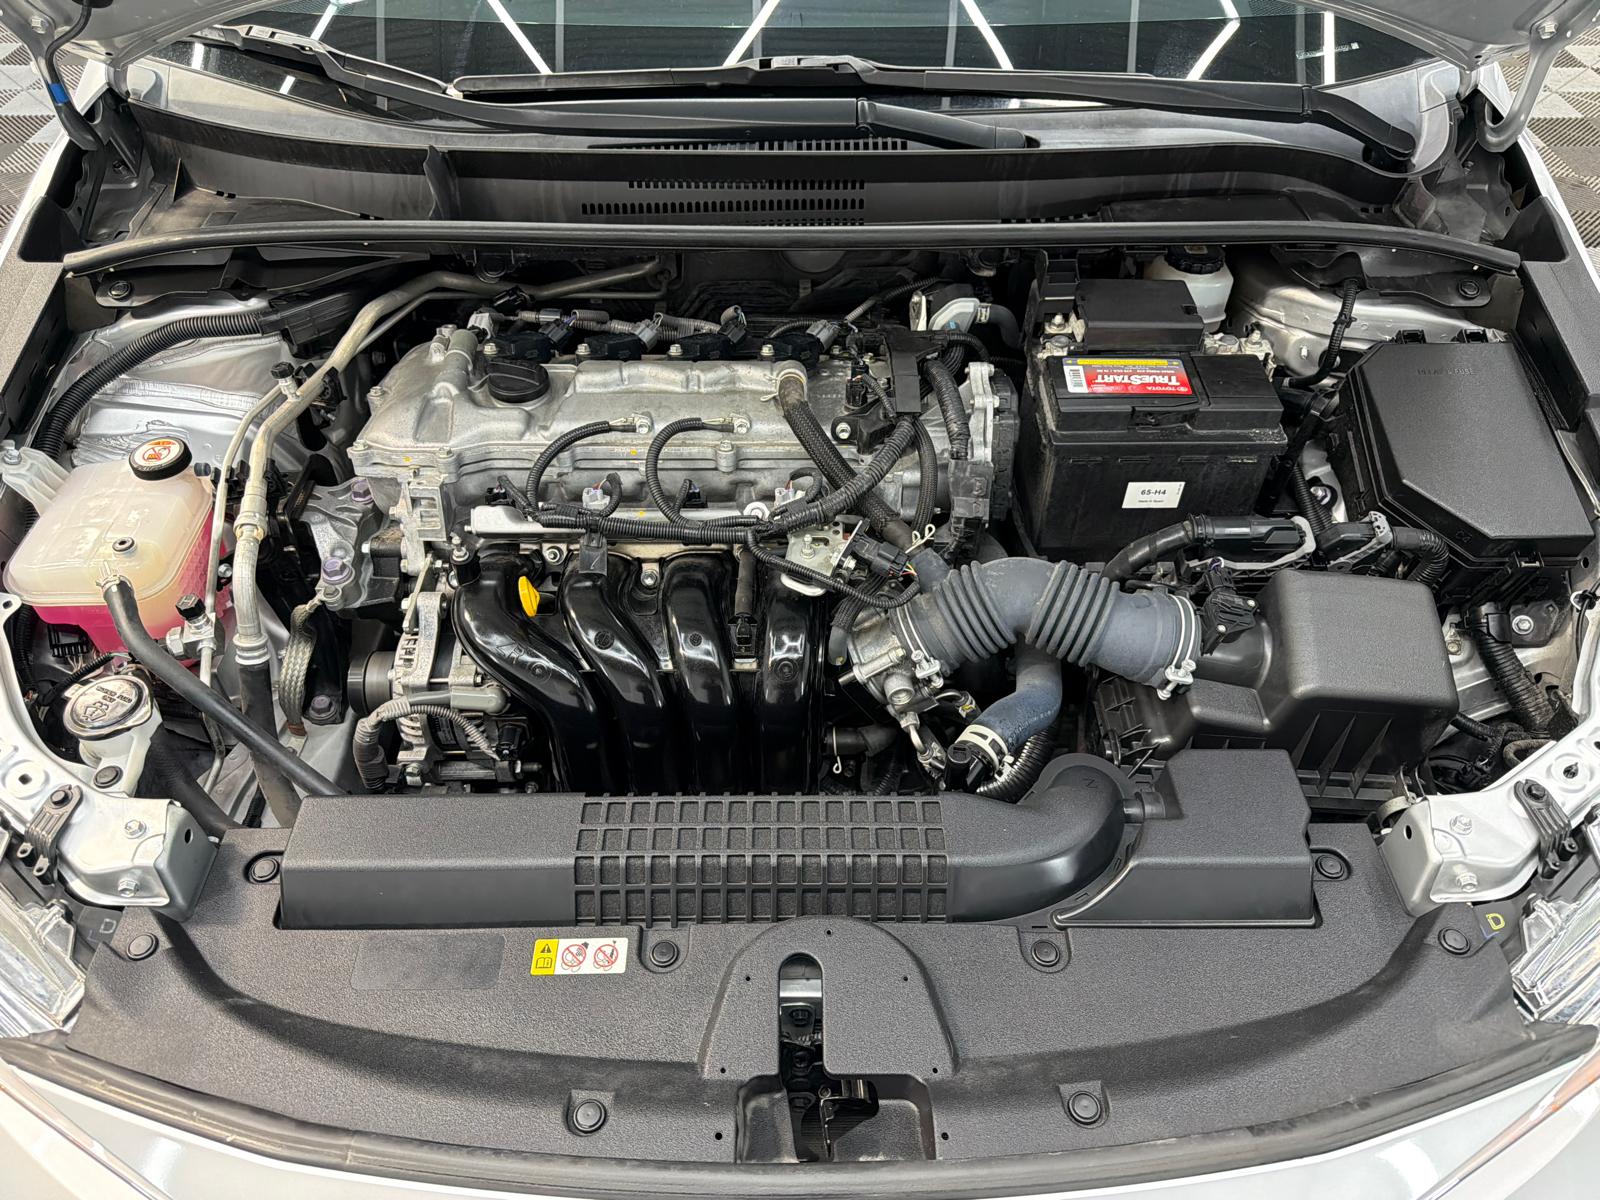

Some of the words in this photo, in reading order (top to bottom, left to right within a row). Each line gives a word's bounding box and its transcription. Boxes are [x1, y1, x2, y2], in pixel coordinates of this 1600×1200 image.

[1096, 375, 1180, 386] TRUESTART
[1455, 530, 1471, 543] C4
[99, 918, 117, 934] D
[1485, 913, 1506, 931] D
